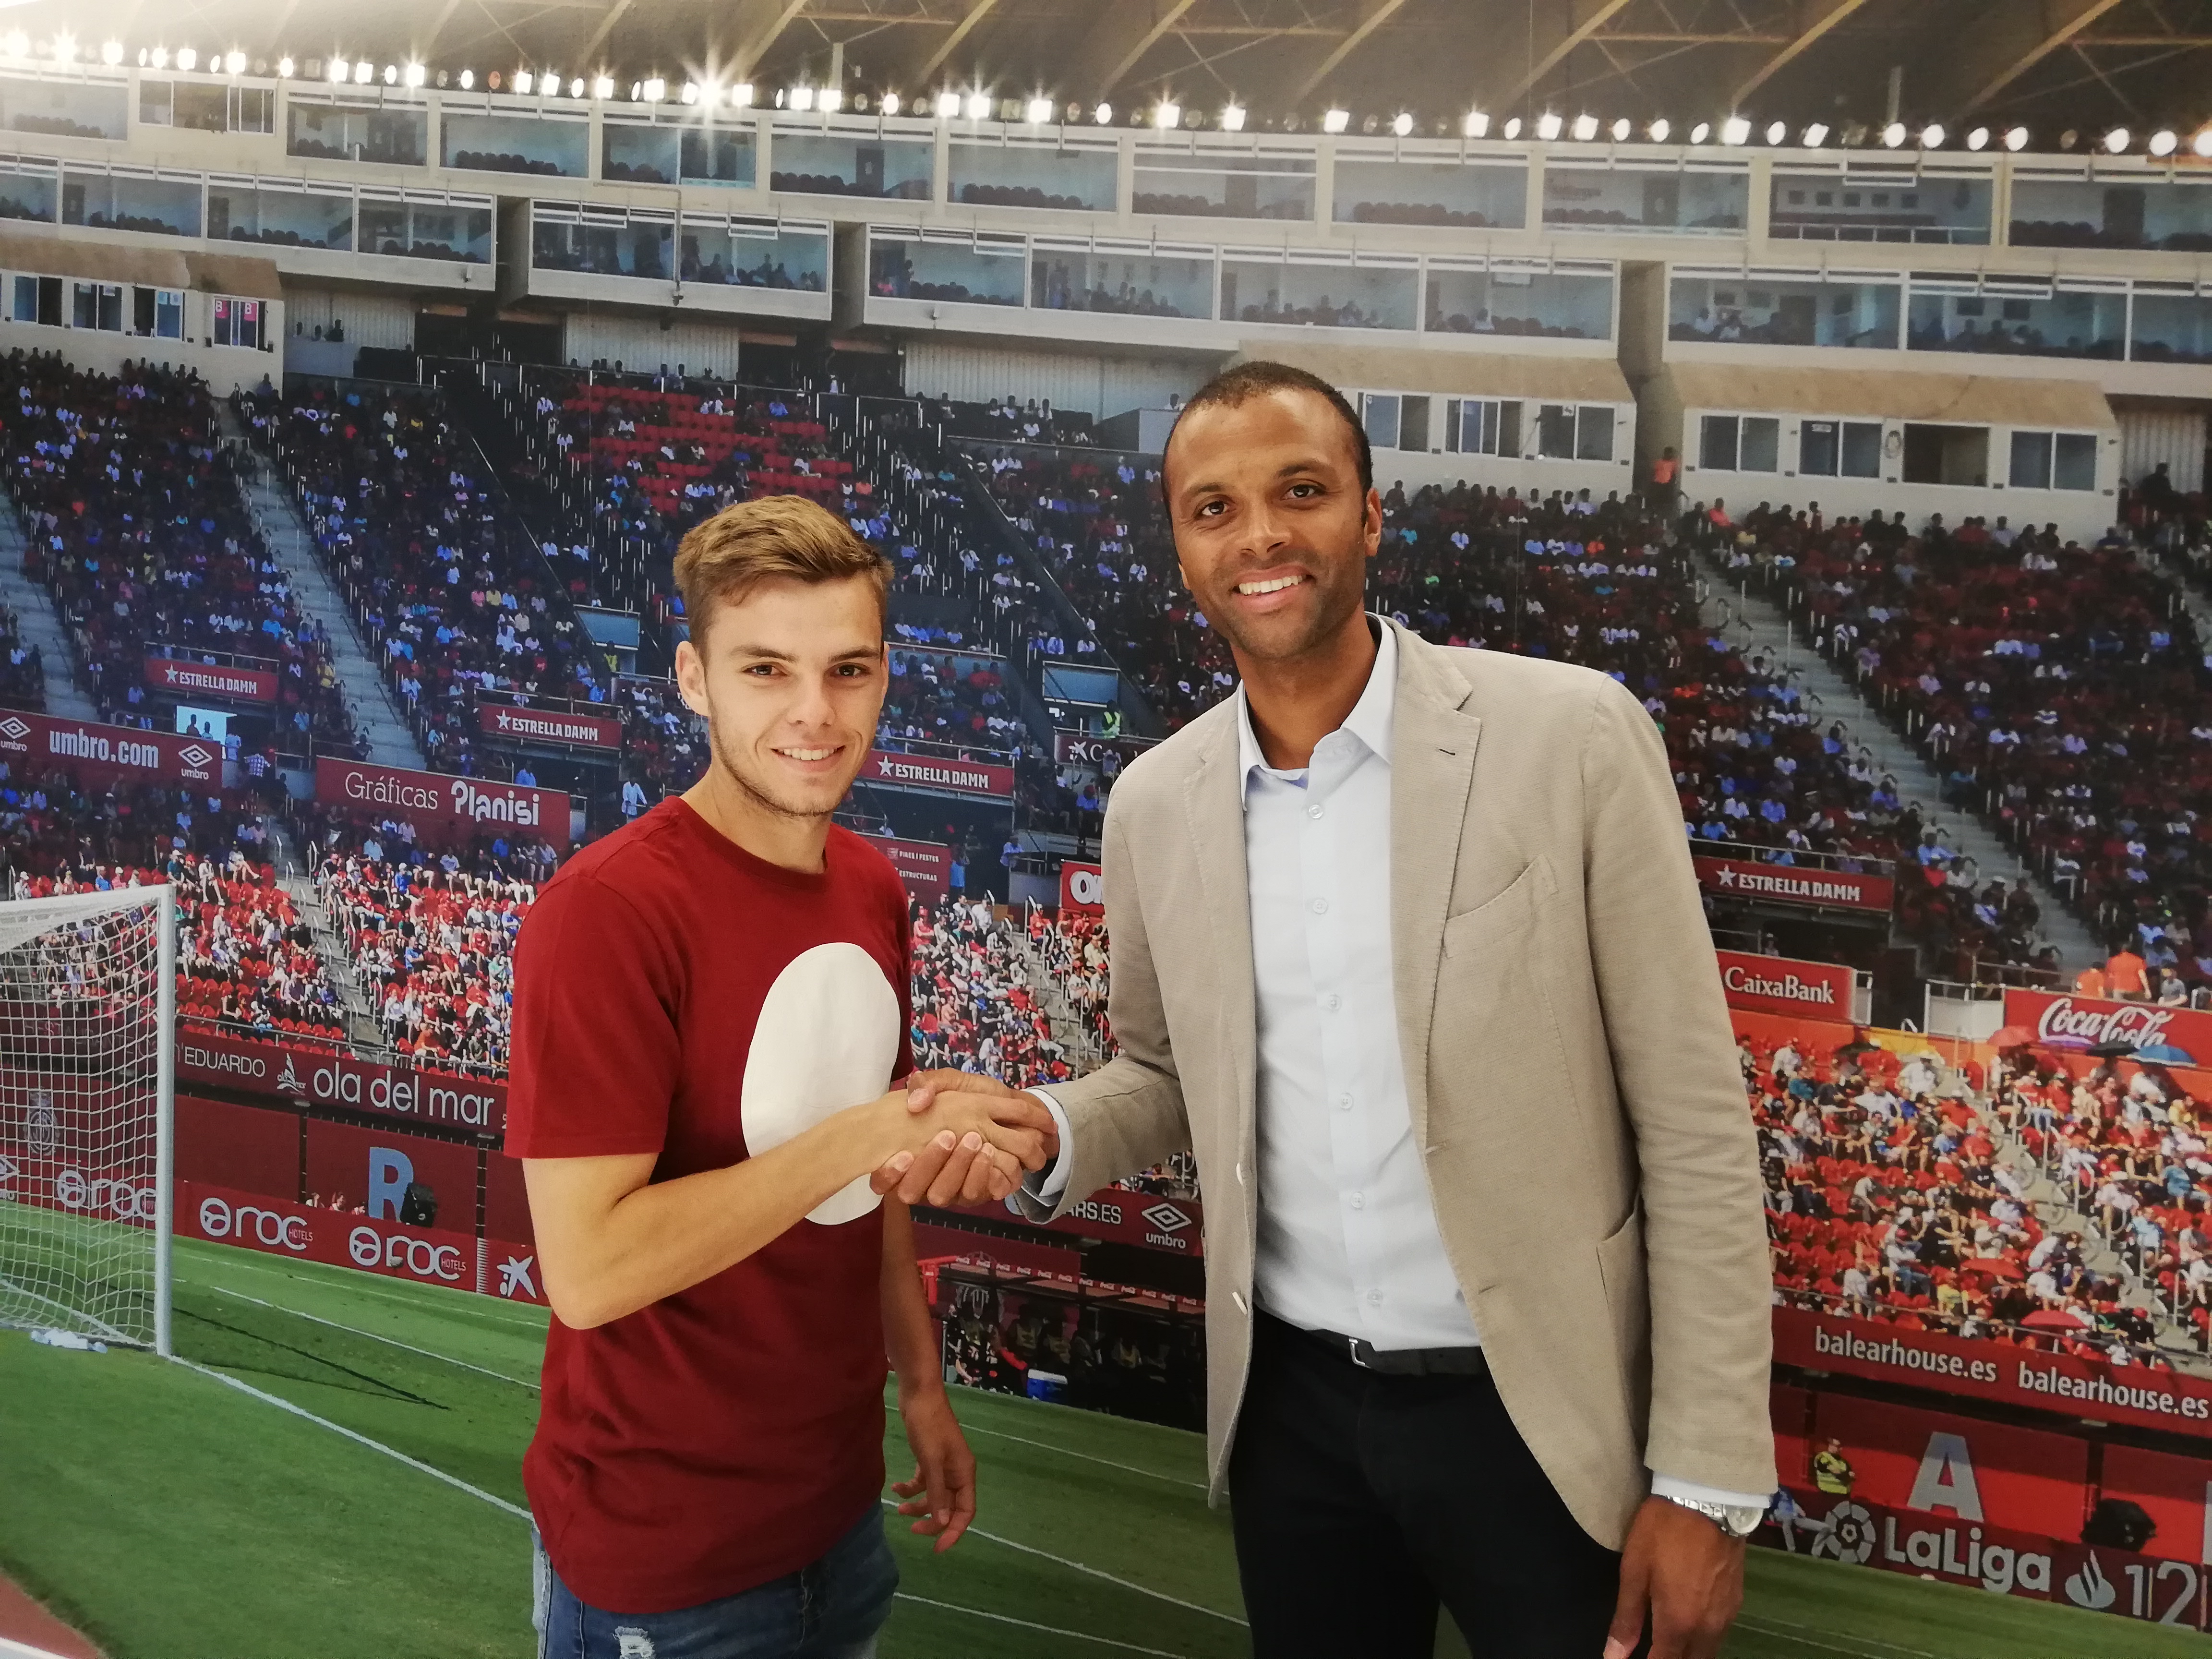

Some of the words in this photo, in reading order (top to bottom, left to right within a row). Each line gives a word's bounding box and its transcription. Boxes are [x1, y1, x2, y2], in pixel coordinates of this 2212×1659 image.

[180, 672, 225, 690] ESTRELLA
[227, 678, 257, 694] DAMM
[1, 740, 27, 752] umbro
[49, 728, 159, 768] umbro.com
[512, 718, 563, 737] ESTRELLA
[565, 724, 598, 741] DAMM
[181, 768, 209, 780] umbro
[895, 763, 950, 783] ESTRELLA
[952, 771, 988, 789] DAMM
[345, 771, 438, 810] Gráficas
[451, 780, 540, 826] Planisi
[1739, 873, 1810, 896] ESTRELLA
[1813, 882, 1860, 902] DAMM
[1725, 966, 1835, 1004] CaixaBank
[313, 1061, 361, 1104] ola
[370, 1070, 419, 1113] del
[430, 1087, 495, 1126] mar
[368, 1146, 414, 1223] R
[236, 1206, 308, 1250] roc
[289, 1228, 313, 1242] HOTELS
[1146, 1232, 1186, 1249] umbro
[386, 1235, 460, 1280] roc
[441, 1257, 466, 1272] HOTELS
[1815, 1325, 1996, 1382] balearhouse.es
[2019, 1361, 2209, 1419] balearhouse.es
[1907, 1431, 1984, 1523] A
[1884, 1516, 2051, 1593] LaLiga
